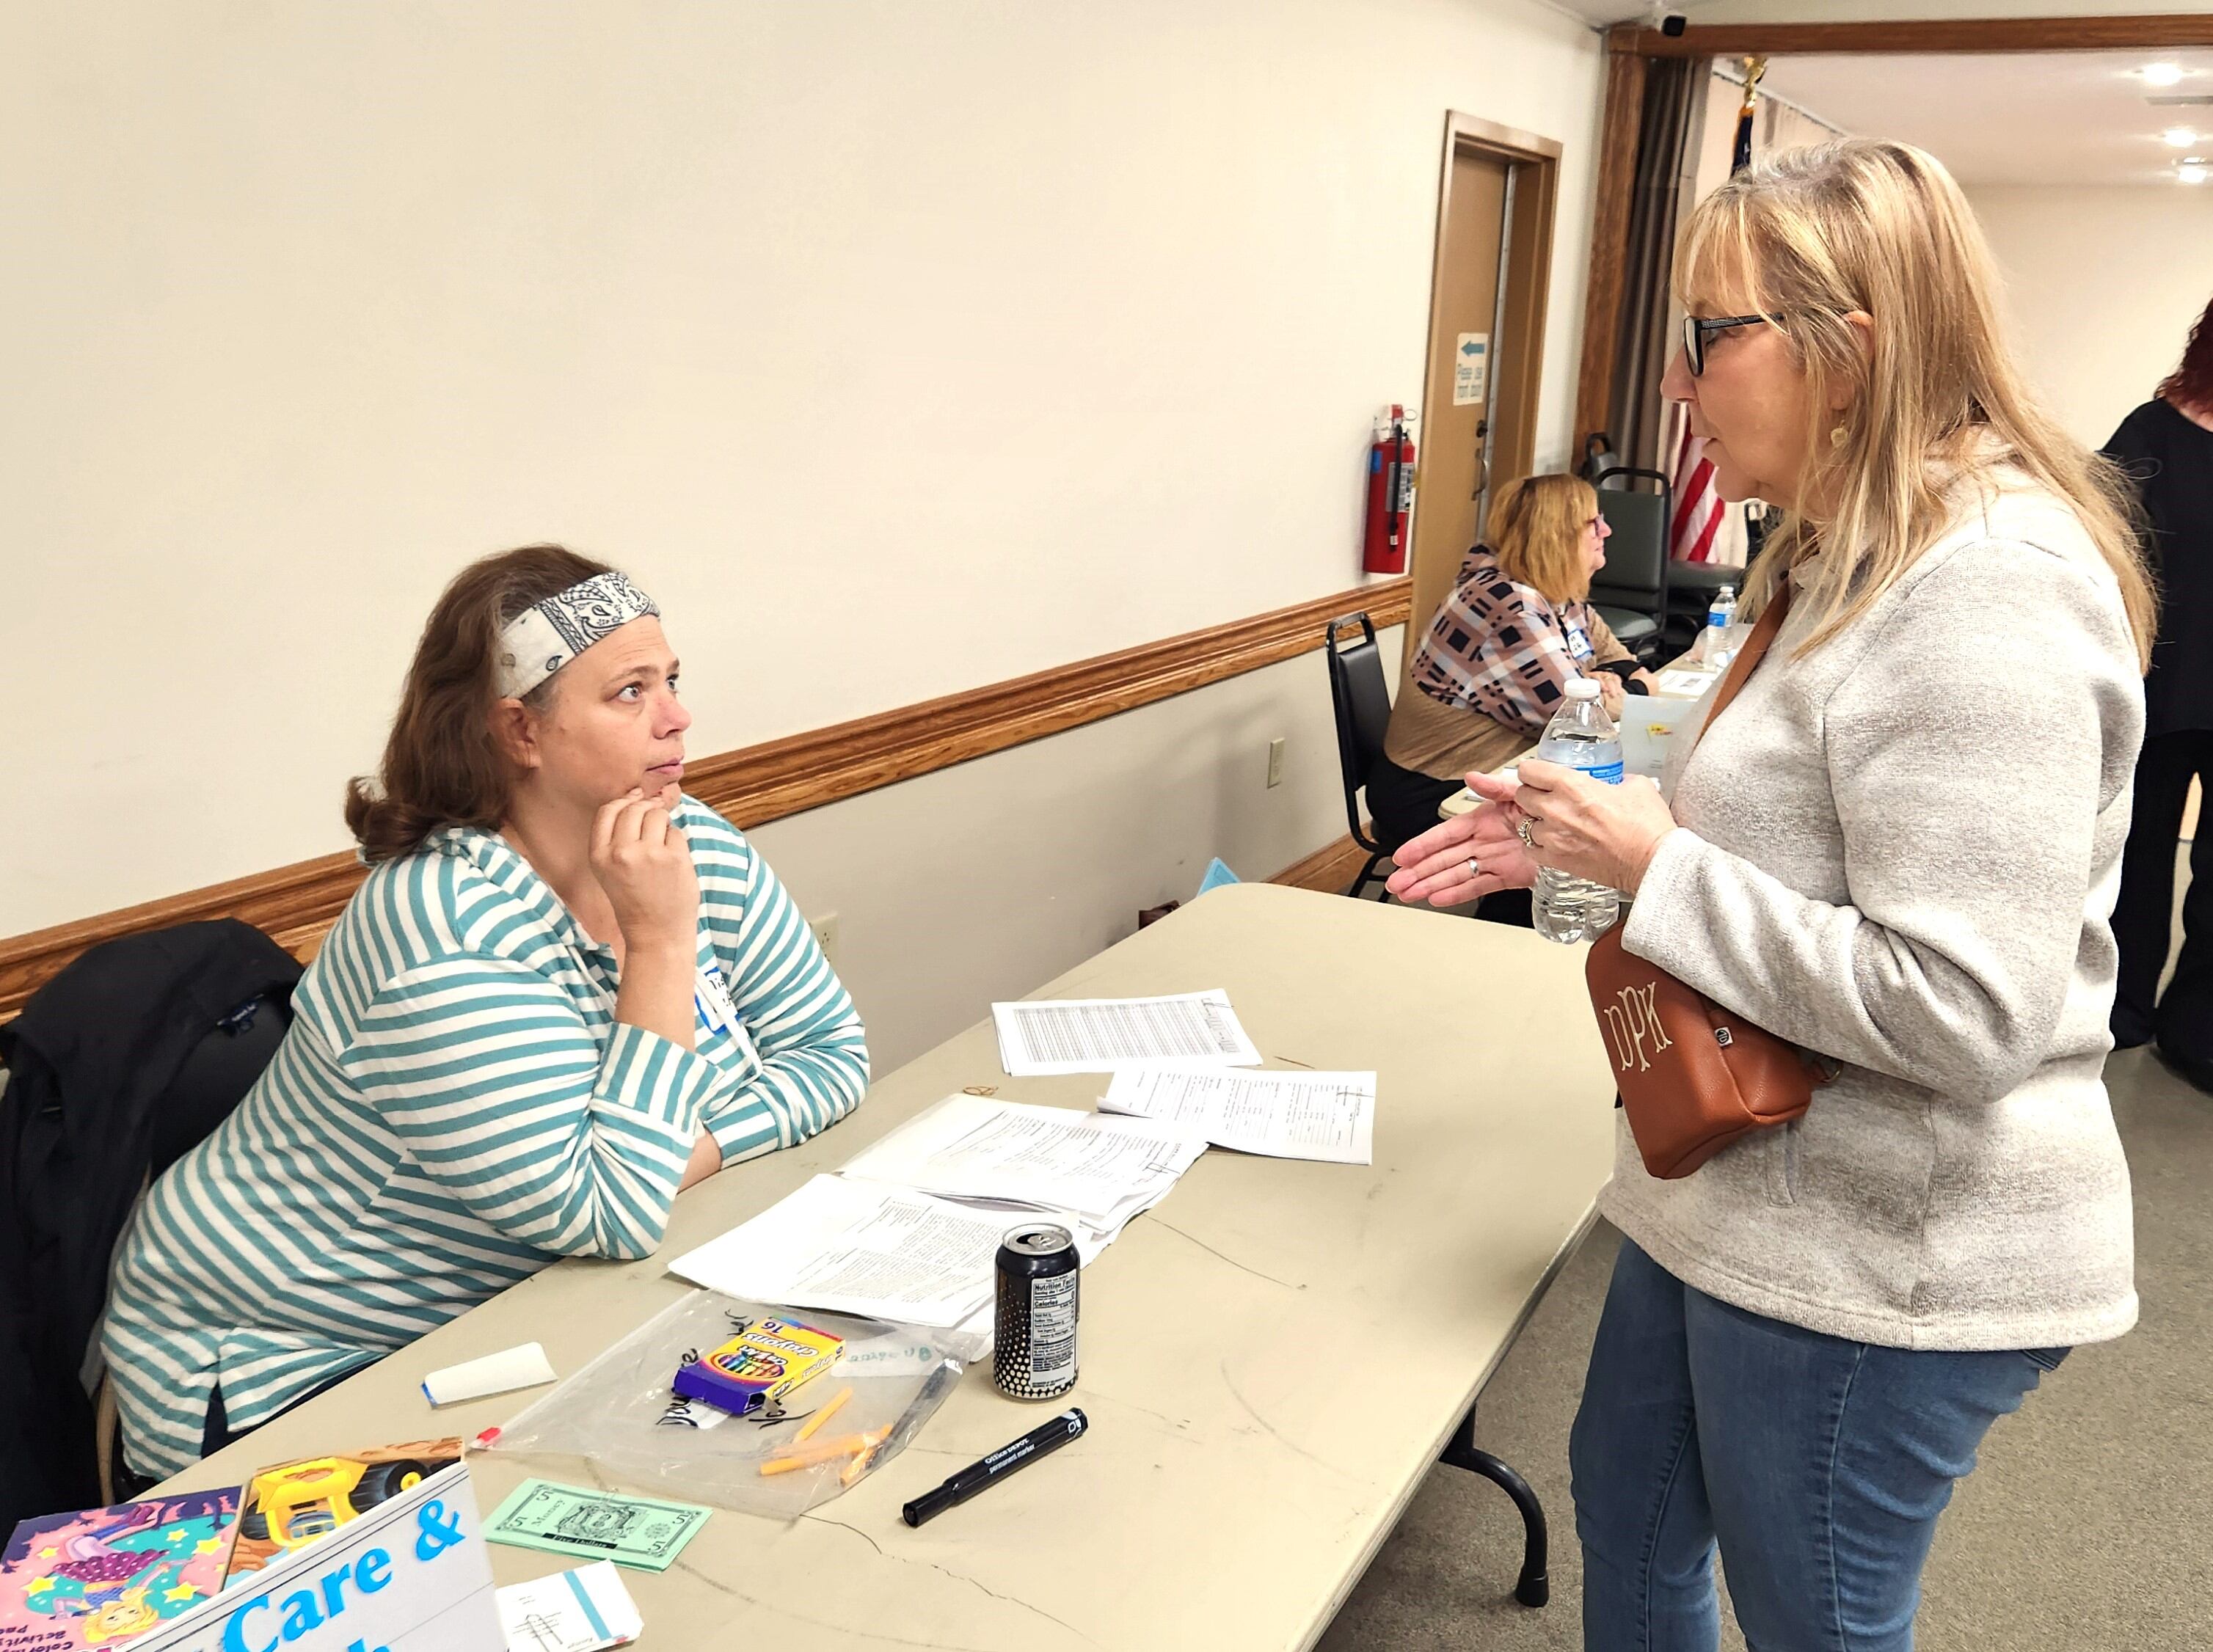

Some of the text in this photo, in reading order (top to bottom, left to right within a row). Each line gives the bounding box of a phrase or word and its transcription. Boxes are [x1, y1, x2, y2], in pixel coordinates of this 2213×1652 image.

[762, 1321, 784, 1334] 16
[741, 1333, 819, 1358] Crayons
[985, 1450, 1008, 1464] Office
[988, 1444, 1035, 1474] permanent marker
[536, 1490, 554, 1501] 5
[509, 1516, 528, 1527] 5
[672, 1513, 691, 1524] 5
[648, 1540, 666, 1551] 5
[222, 1499, 467, 1652] Care &
